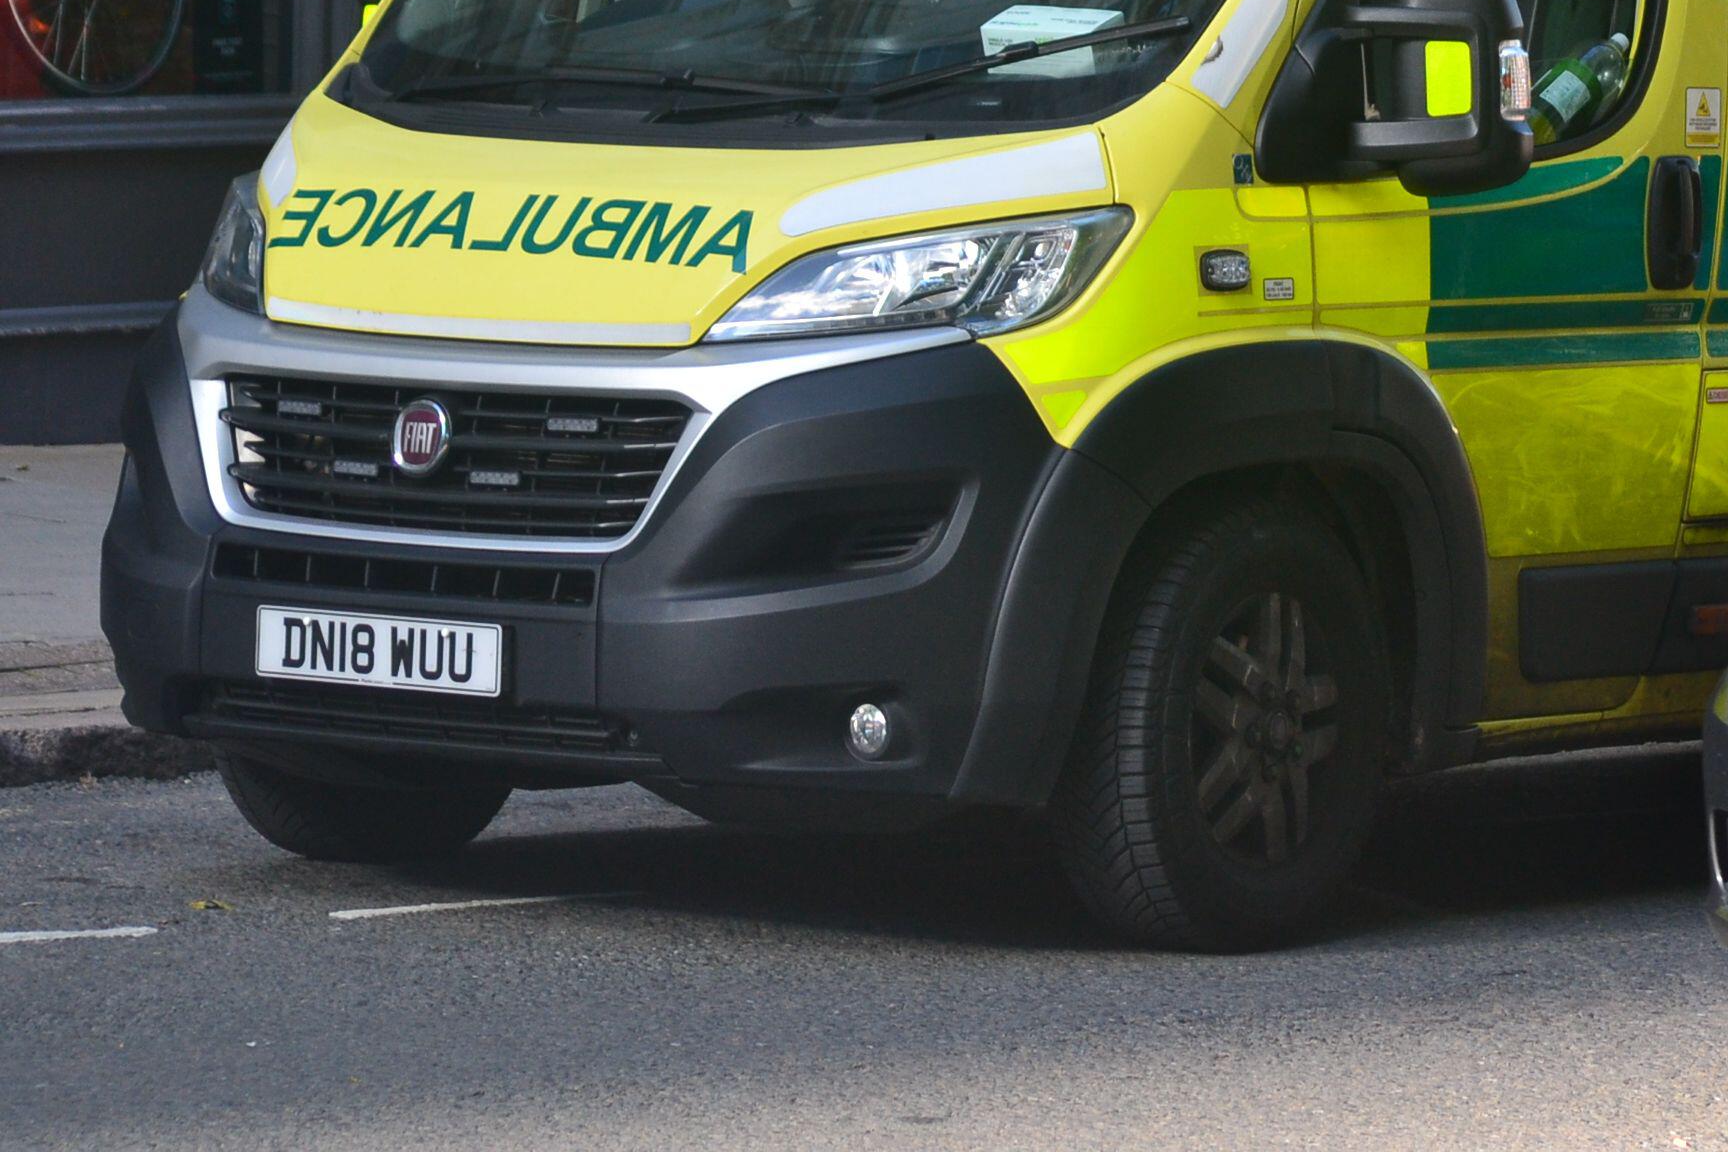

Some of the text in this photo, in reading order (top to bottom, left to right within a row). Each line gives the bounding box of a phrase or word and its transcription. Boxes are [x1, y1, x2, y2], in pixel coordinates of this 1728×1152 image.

[403, 421, 437, 454] FIAT
[282, 617, 474, 684] DN18 WUU
